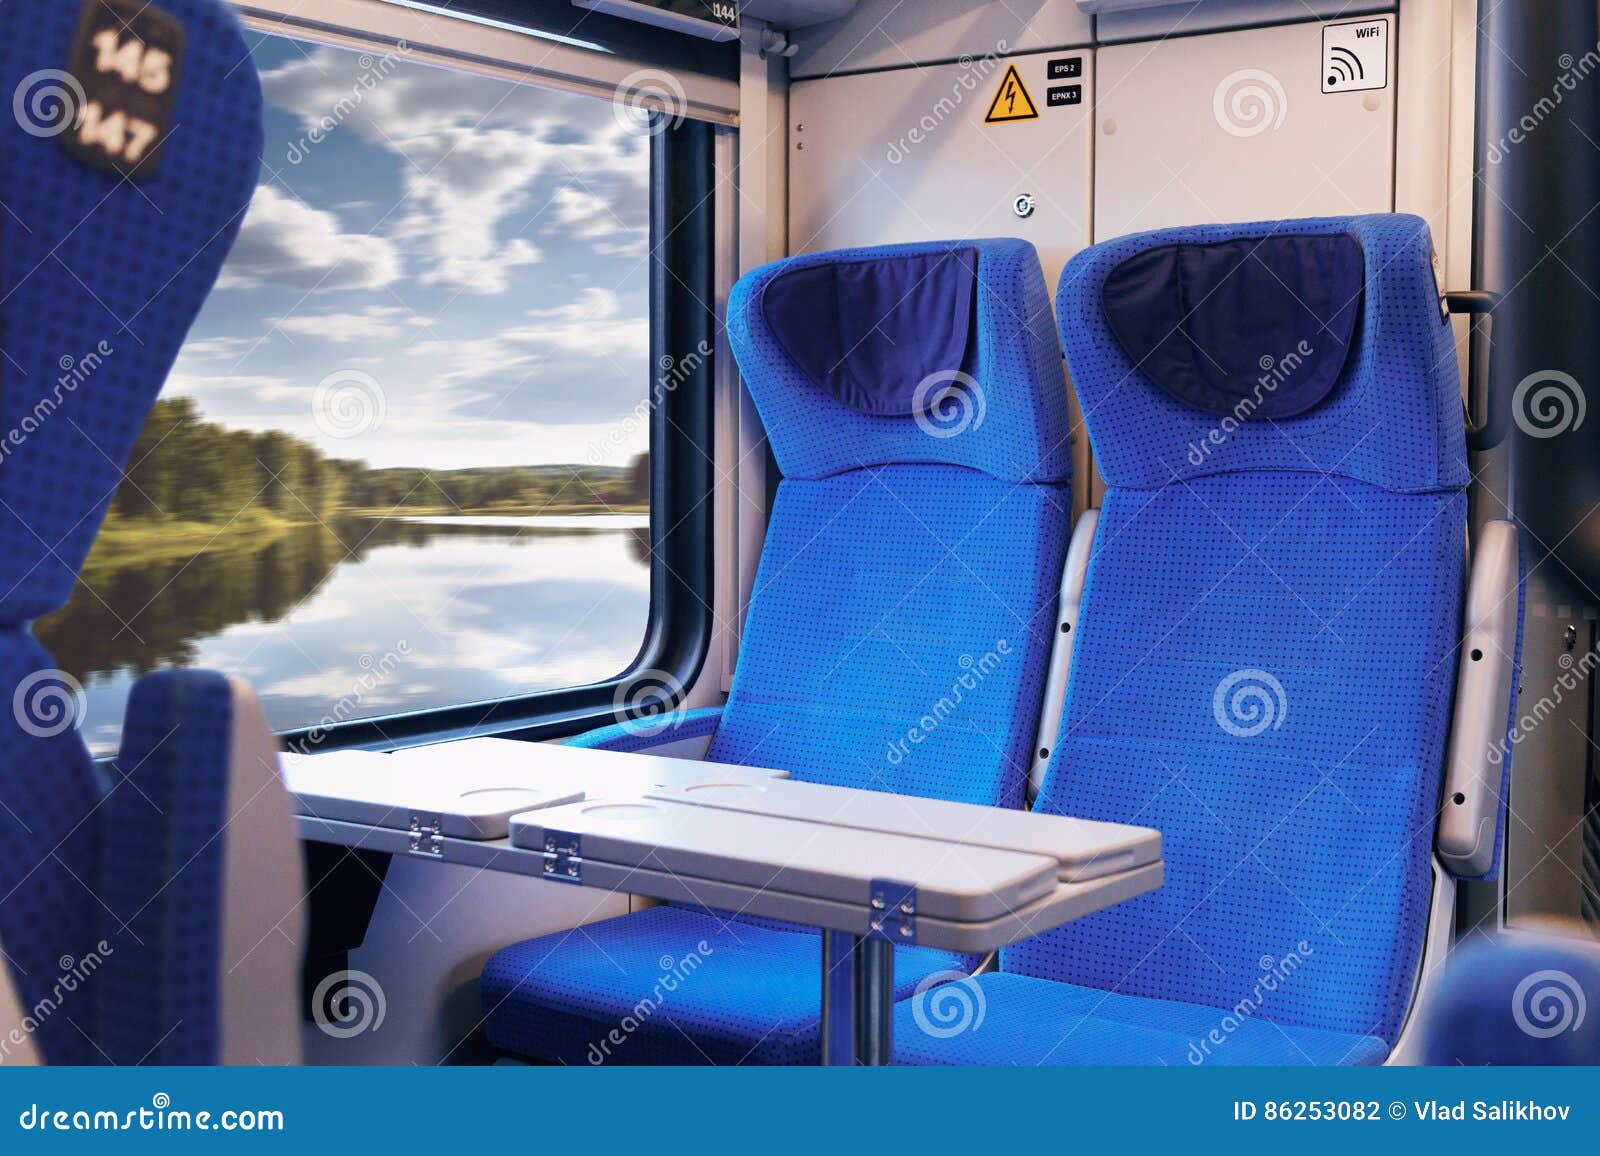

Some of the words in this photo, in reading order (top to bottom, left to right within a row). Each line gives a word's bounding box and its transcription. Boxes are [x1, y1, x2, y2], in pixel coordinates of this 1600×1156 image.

[1356, 26, 1379, 38] WiFi
[93, 28, 172, 94] 145
[1054, 65, 1069, 73] EPS
[1070, 64, 1075, 72] 2
[1051, 92, 1071, 101] EPNX
[1072, 91, 1077, 99] 3
[77, 103, 157, 162] 147
